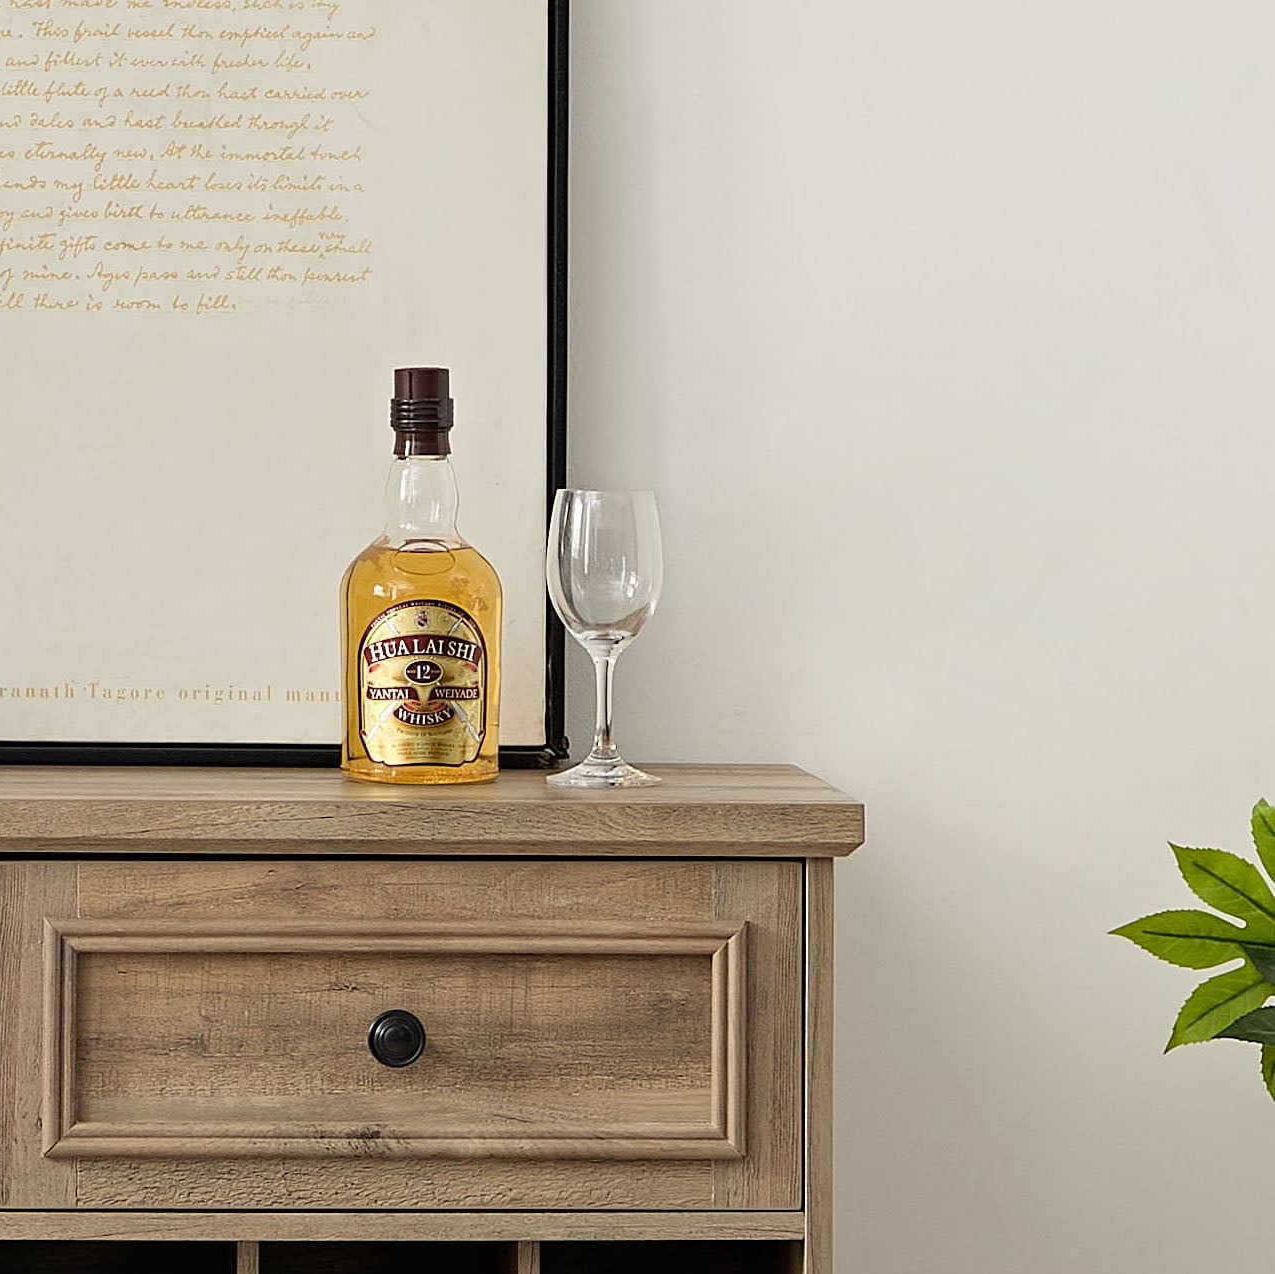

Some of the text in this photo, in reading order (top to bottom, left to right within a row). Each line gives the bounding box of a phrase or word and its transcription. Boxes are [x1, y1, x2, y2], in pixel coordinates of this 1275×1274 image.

[127, 0, 153, 8] me
[31, 20, 69, 37] This
[74, 20, 121, 43] frail
[127, 24, 175, 38] vessel
[182, 25, 214, 39] thou
[219, 25, 290, 48] emptiest
[292, 26, 343, 51] again
[347, 27, 375, 40] and
[6, 55, 39, 66] and
[108, 52, 126, 67] it
[130, 58, 166, 67] ever
[172, 51, 206, 67] with
[211, 53, 269, 75] fresher
[0, 79, 38, 96] little
[43, 80, 89, 102] flute
[94, 87, 110, 108] of
[114, 89, 123, 97] a
[129, 84, 170, 97] reed
[176, 83, 210, 98] thou
[217, 82, 258, 99] hast
[264, 86, 326, 102] carried
[330, 91, 369, 99] over
[29, 112, 74, 128] dales
[82, 115, 116, 127] and
[124, 110, 166, 129] hast
[171, 110, 243, 129] breathed
[248, 114, 311, 139] through
[313, 115, 334, 131] it
[24, 141, 107, 171] eternally
[190, 144, 213, 159] the
[220, 145, 305, 160] immortal
[54, 179, 83, 203] my
[90, 174, 140, 190] little
[146, 170, 200, 191] heart
[204, 172, 243, 191] loses
[247, 174, 268, 191] its
[272, 174, 326, 192] limits
[329, 176, 350, 192] in
[353, 184, 364, 192] a
[20, 206, 53, 219] and
[58, 207, 99, 226] gives
[104, 201, 143, 219] birth
[149, 204, 164, 219] to
[171, 204, 255, 221] utterance
[319, 231, 347, 240] very
[58, 235, 98, 260] gifts
[104, 240, 150, 249] come
[158, 236, 173, 249] to
[180, 242, 208, 250] me
[215, 236, 250, 264] only
[254, 244, 272, 253] on
[277, 239, 320, 253] these
[325, 240, 372, 254] small
[0, 267, 14, 291] of
[22, 264, 79, 280] mine.
[87, 261, 129, 291] Ages
[134, 266, 177, 286] pass
[186, 266, 220, 279] and
[225, 265, 263, 281] still
[266, 266, 297, 281] thou
[33, 294, 78, 309] there
[86, 294, 102, 310] is
[112, 300, 160, 309] room
[172, 296, 189, 310] to
[197, 294, 236, 314] fill.
[415, 665, 431, 680] 12
[86, 682, 166, 702] Tagore
[179, 684, 273, 704] original
[369, 687, 479, 700] YANTAI WEIYADE
[397, 707, 454, 726] WHISKY
